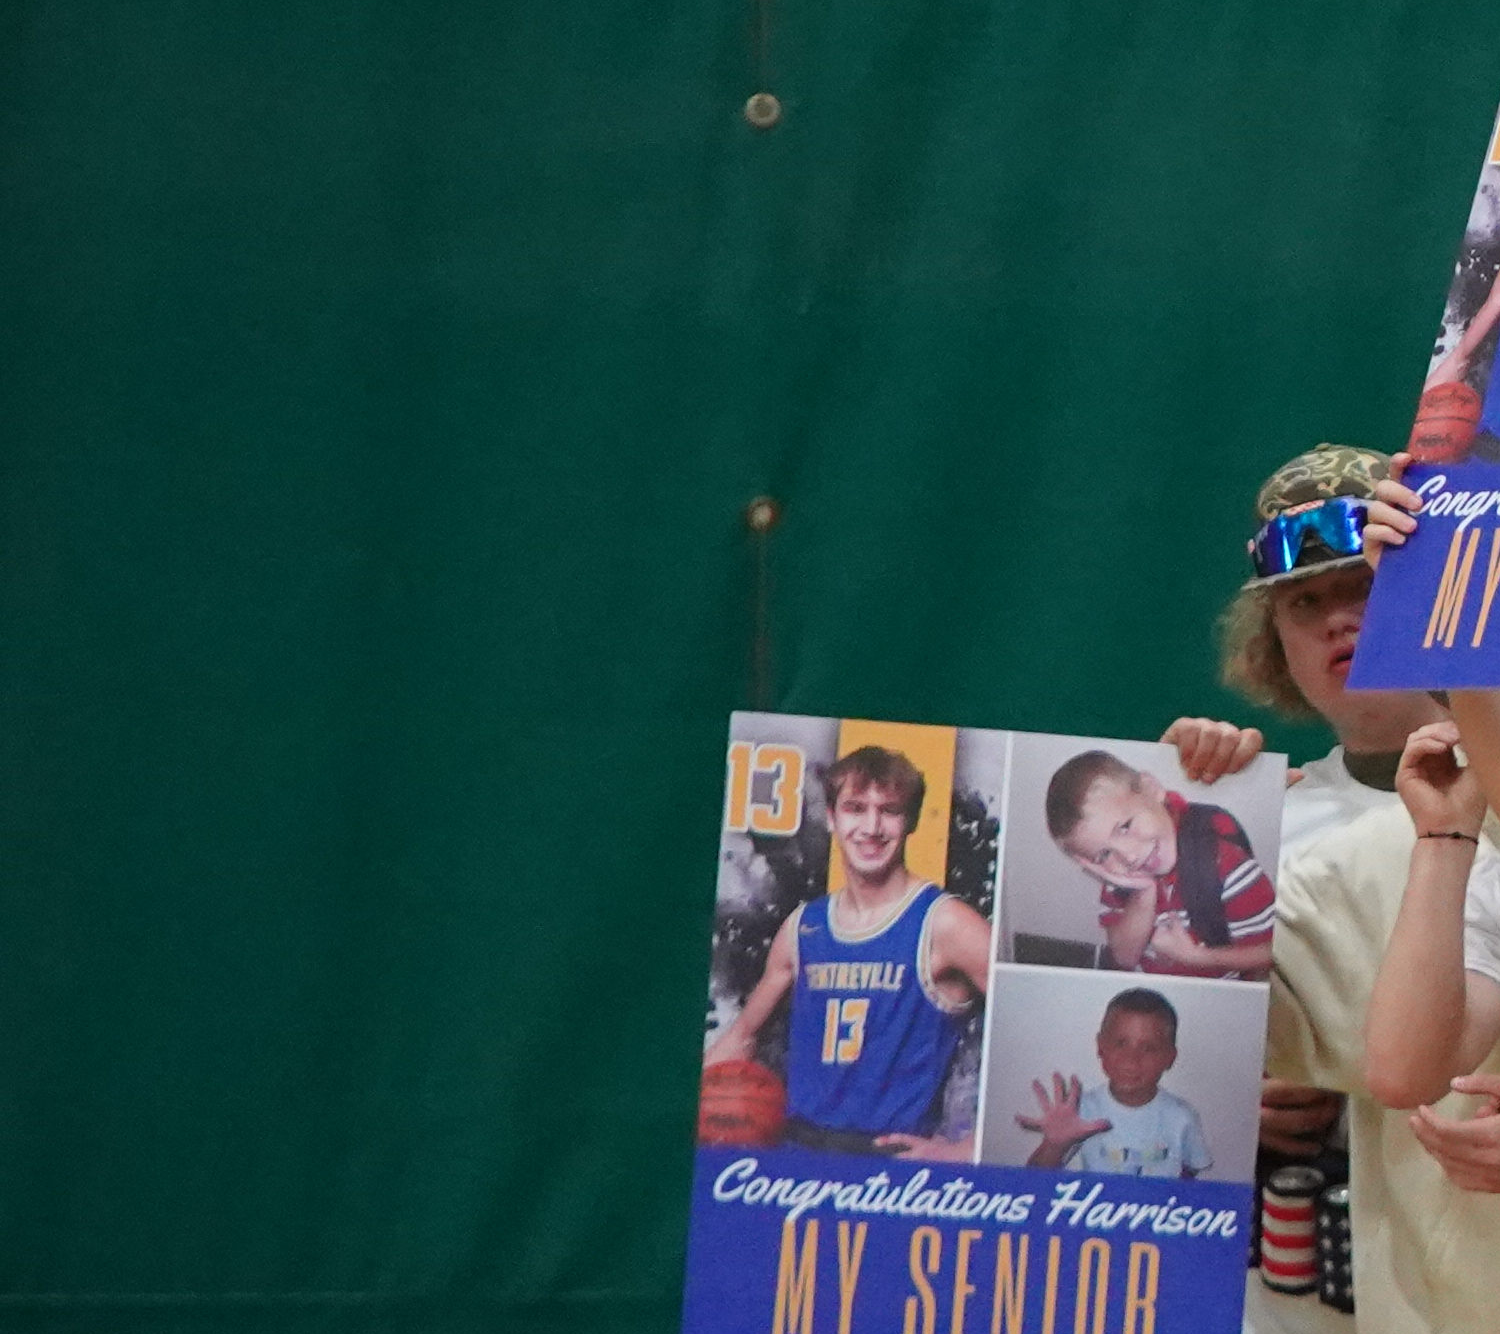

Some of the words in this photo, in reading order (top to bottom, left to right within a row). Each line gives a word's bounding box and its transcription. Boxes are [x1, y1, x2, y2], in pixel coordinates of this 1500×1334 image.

[726, 741, 806, 837] 13
[821, 998, 871, 1065] 13
[712, 1160, 1034, 1224] Congratulations
[1047, 1182, 1238, 1238] Harrison
